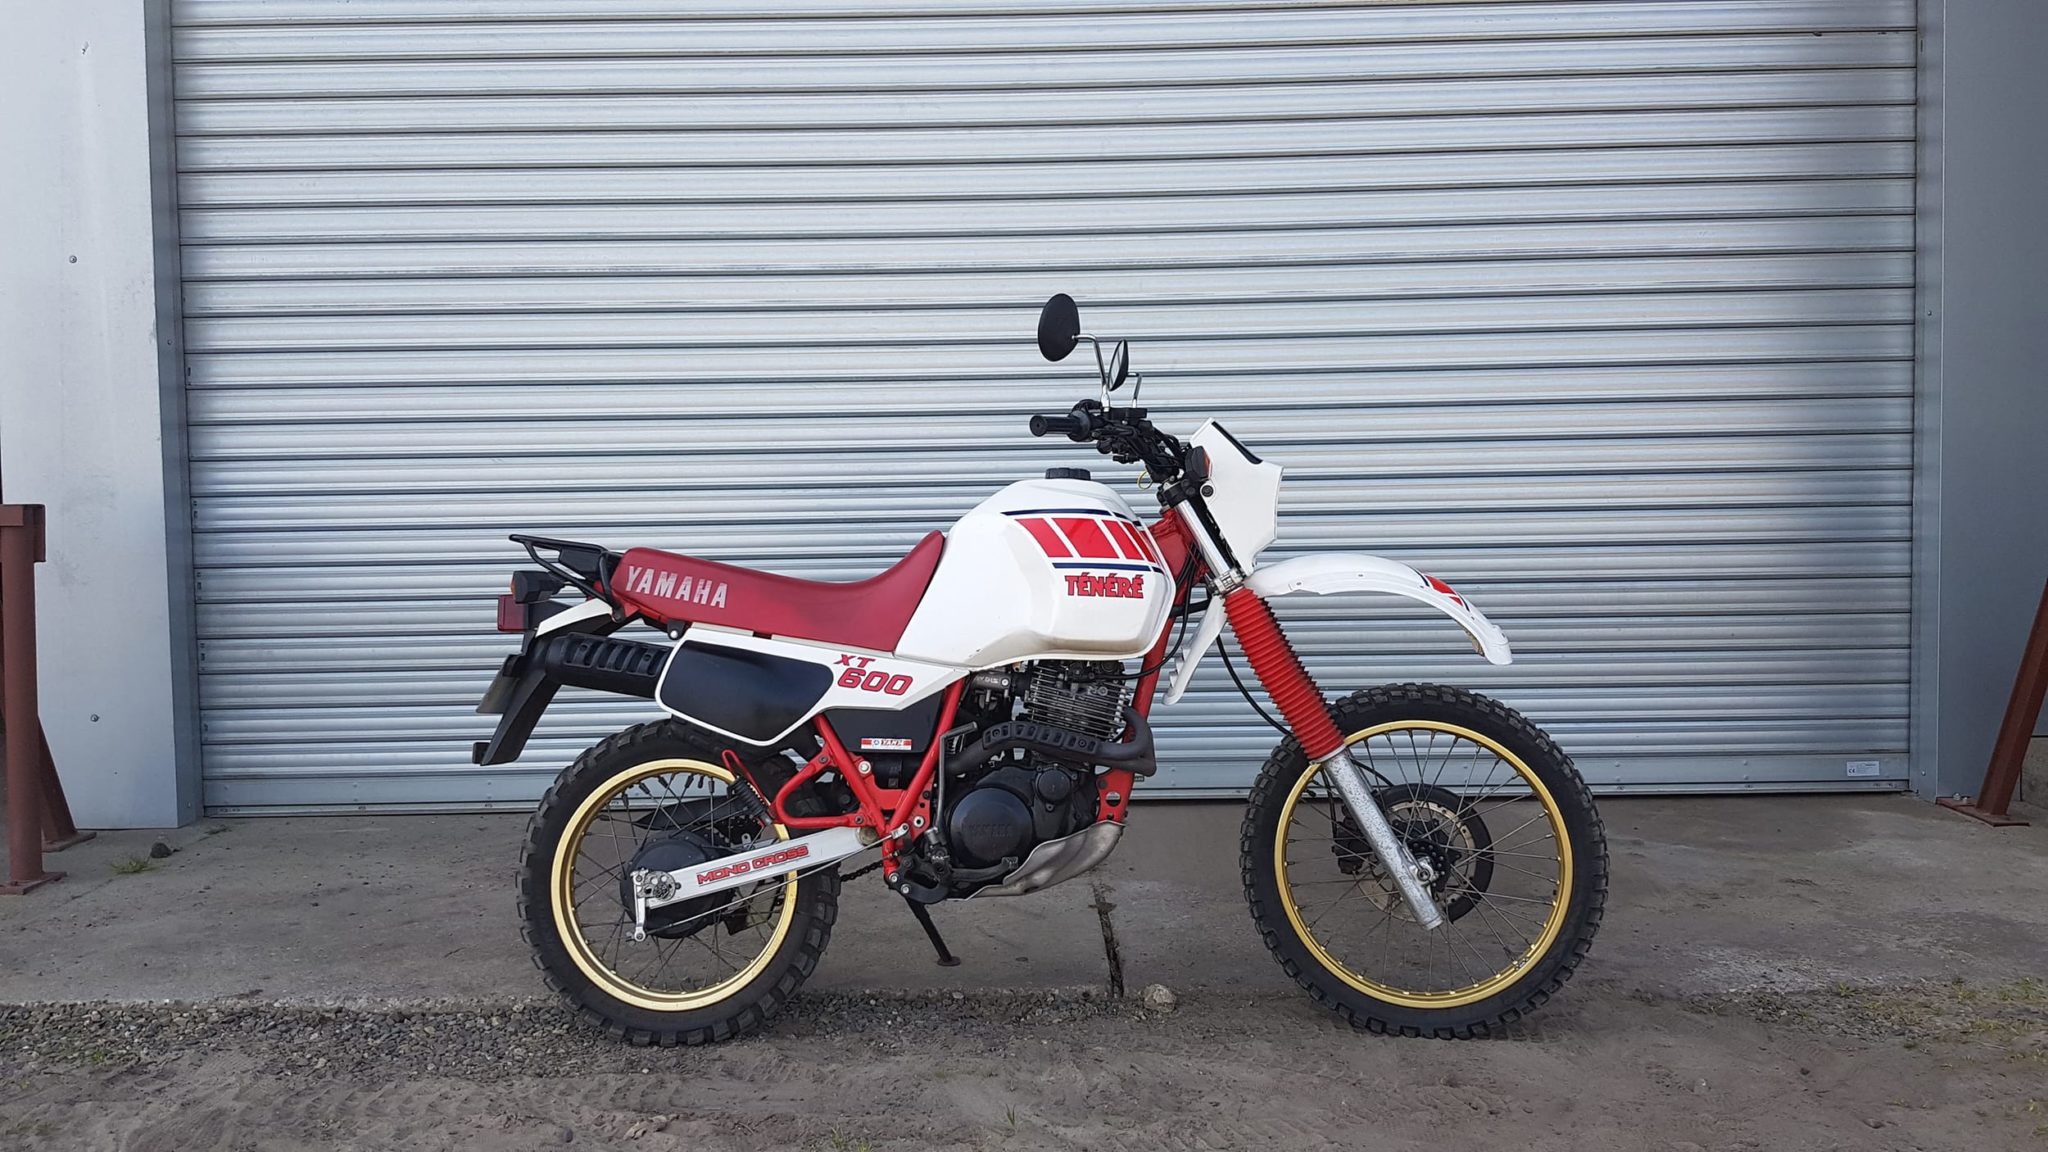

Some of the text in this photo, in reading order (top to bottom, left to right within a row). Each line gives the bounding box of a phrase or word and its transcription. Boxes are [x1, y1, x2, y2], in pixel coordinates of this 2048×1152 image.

[625, 565, 728, 609] YAMAHA
[1064, 572, 1144, 599] TÉNÉRÉ
[833, 653, 876, 668] XT
[837, 667, 914, 696] 600
[696, 845, 809, 885] MONO CROSS
